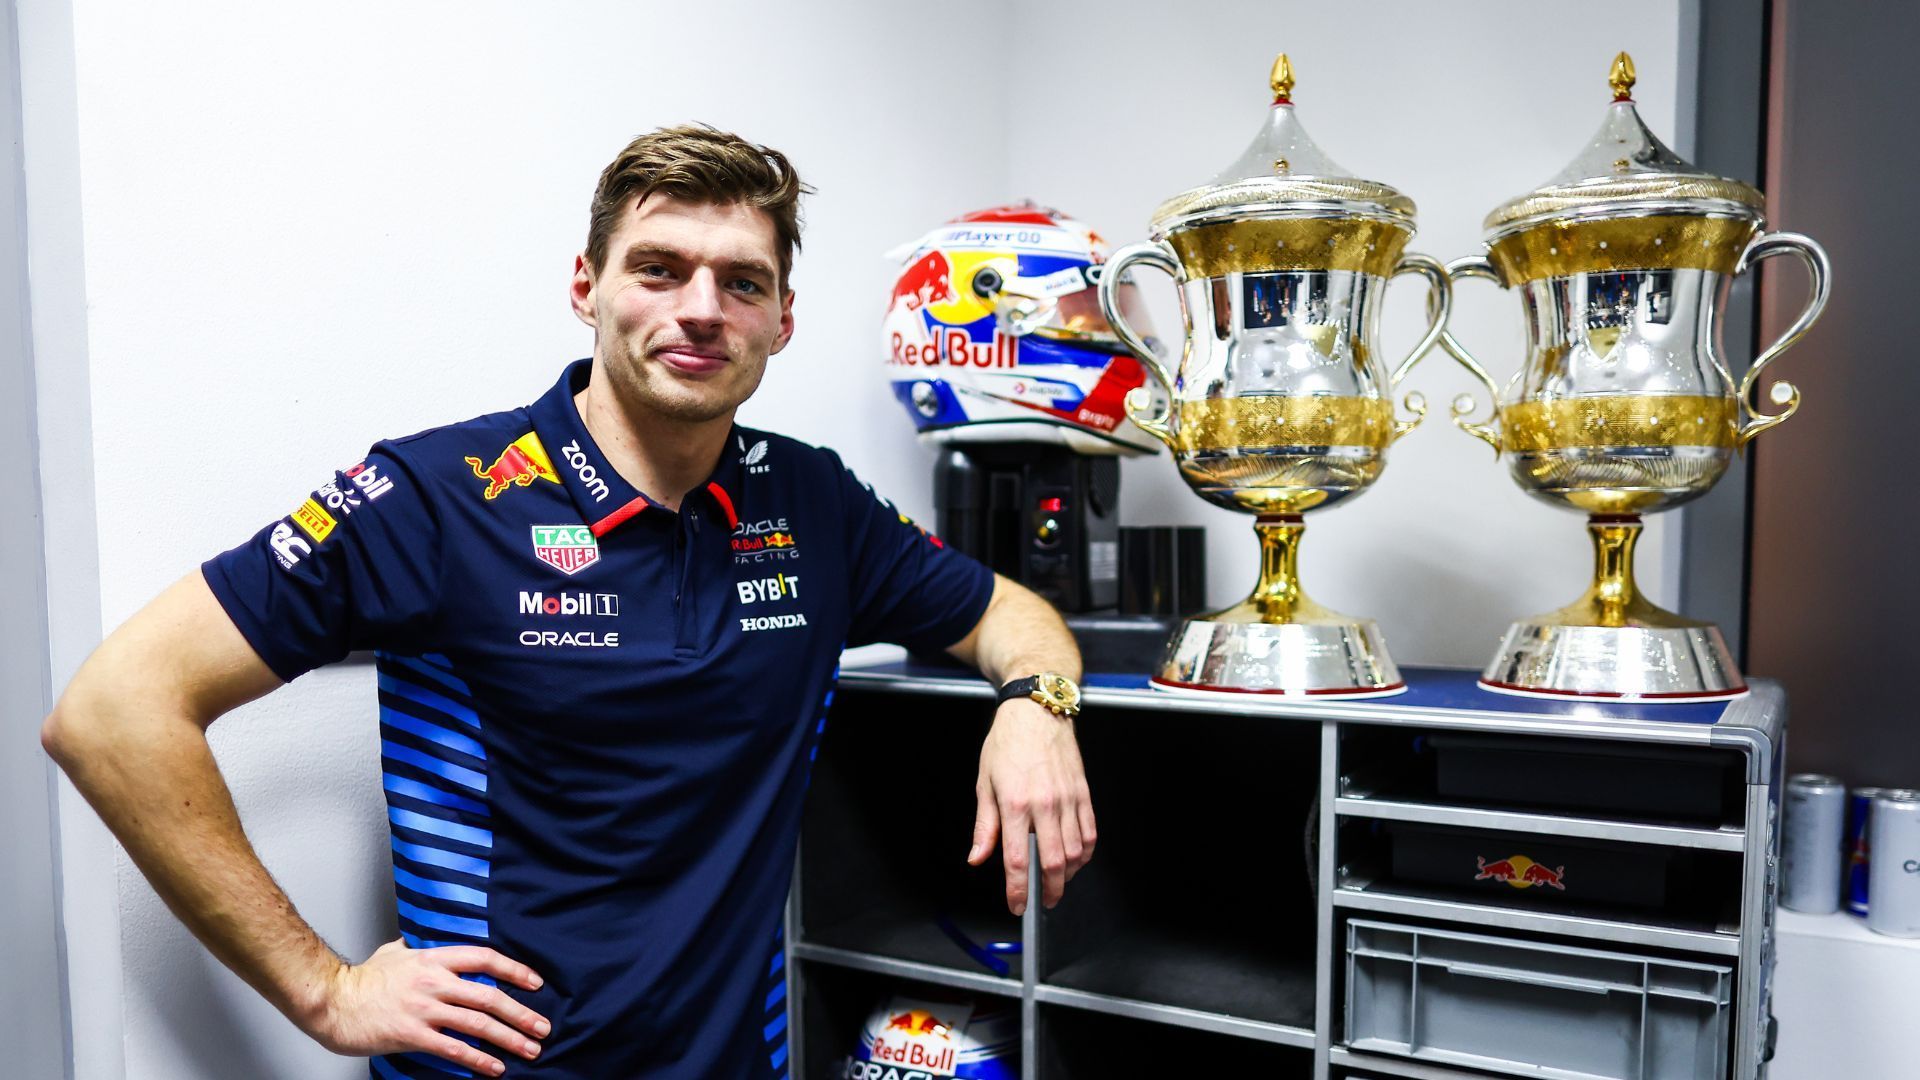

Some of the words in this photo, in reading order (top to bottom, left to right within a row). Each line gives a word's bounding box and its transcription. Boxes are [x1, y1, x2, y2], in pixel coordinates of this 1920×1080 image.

[892, 330, 939, 366] Red
[947, 331, 1014, 368] Bull
[345, 462, 394, 500] obil
[562, 440, 610, 503] zoom
[538, 528, 592, 545] TAG
[538, 548, 595, 571] HEUER
[519, 591, 592, 615] Mobil
[740, 614, 807, 632] HONDA
[519, 630, 619, 647] ORACLE
[872, 1037, 908, 1063] Red
[910, 1043, 954, 1071] Bull
